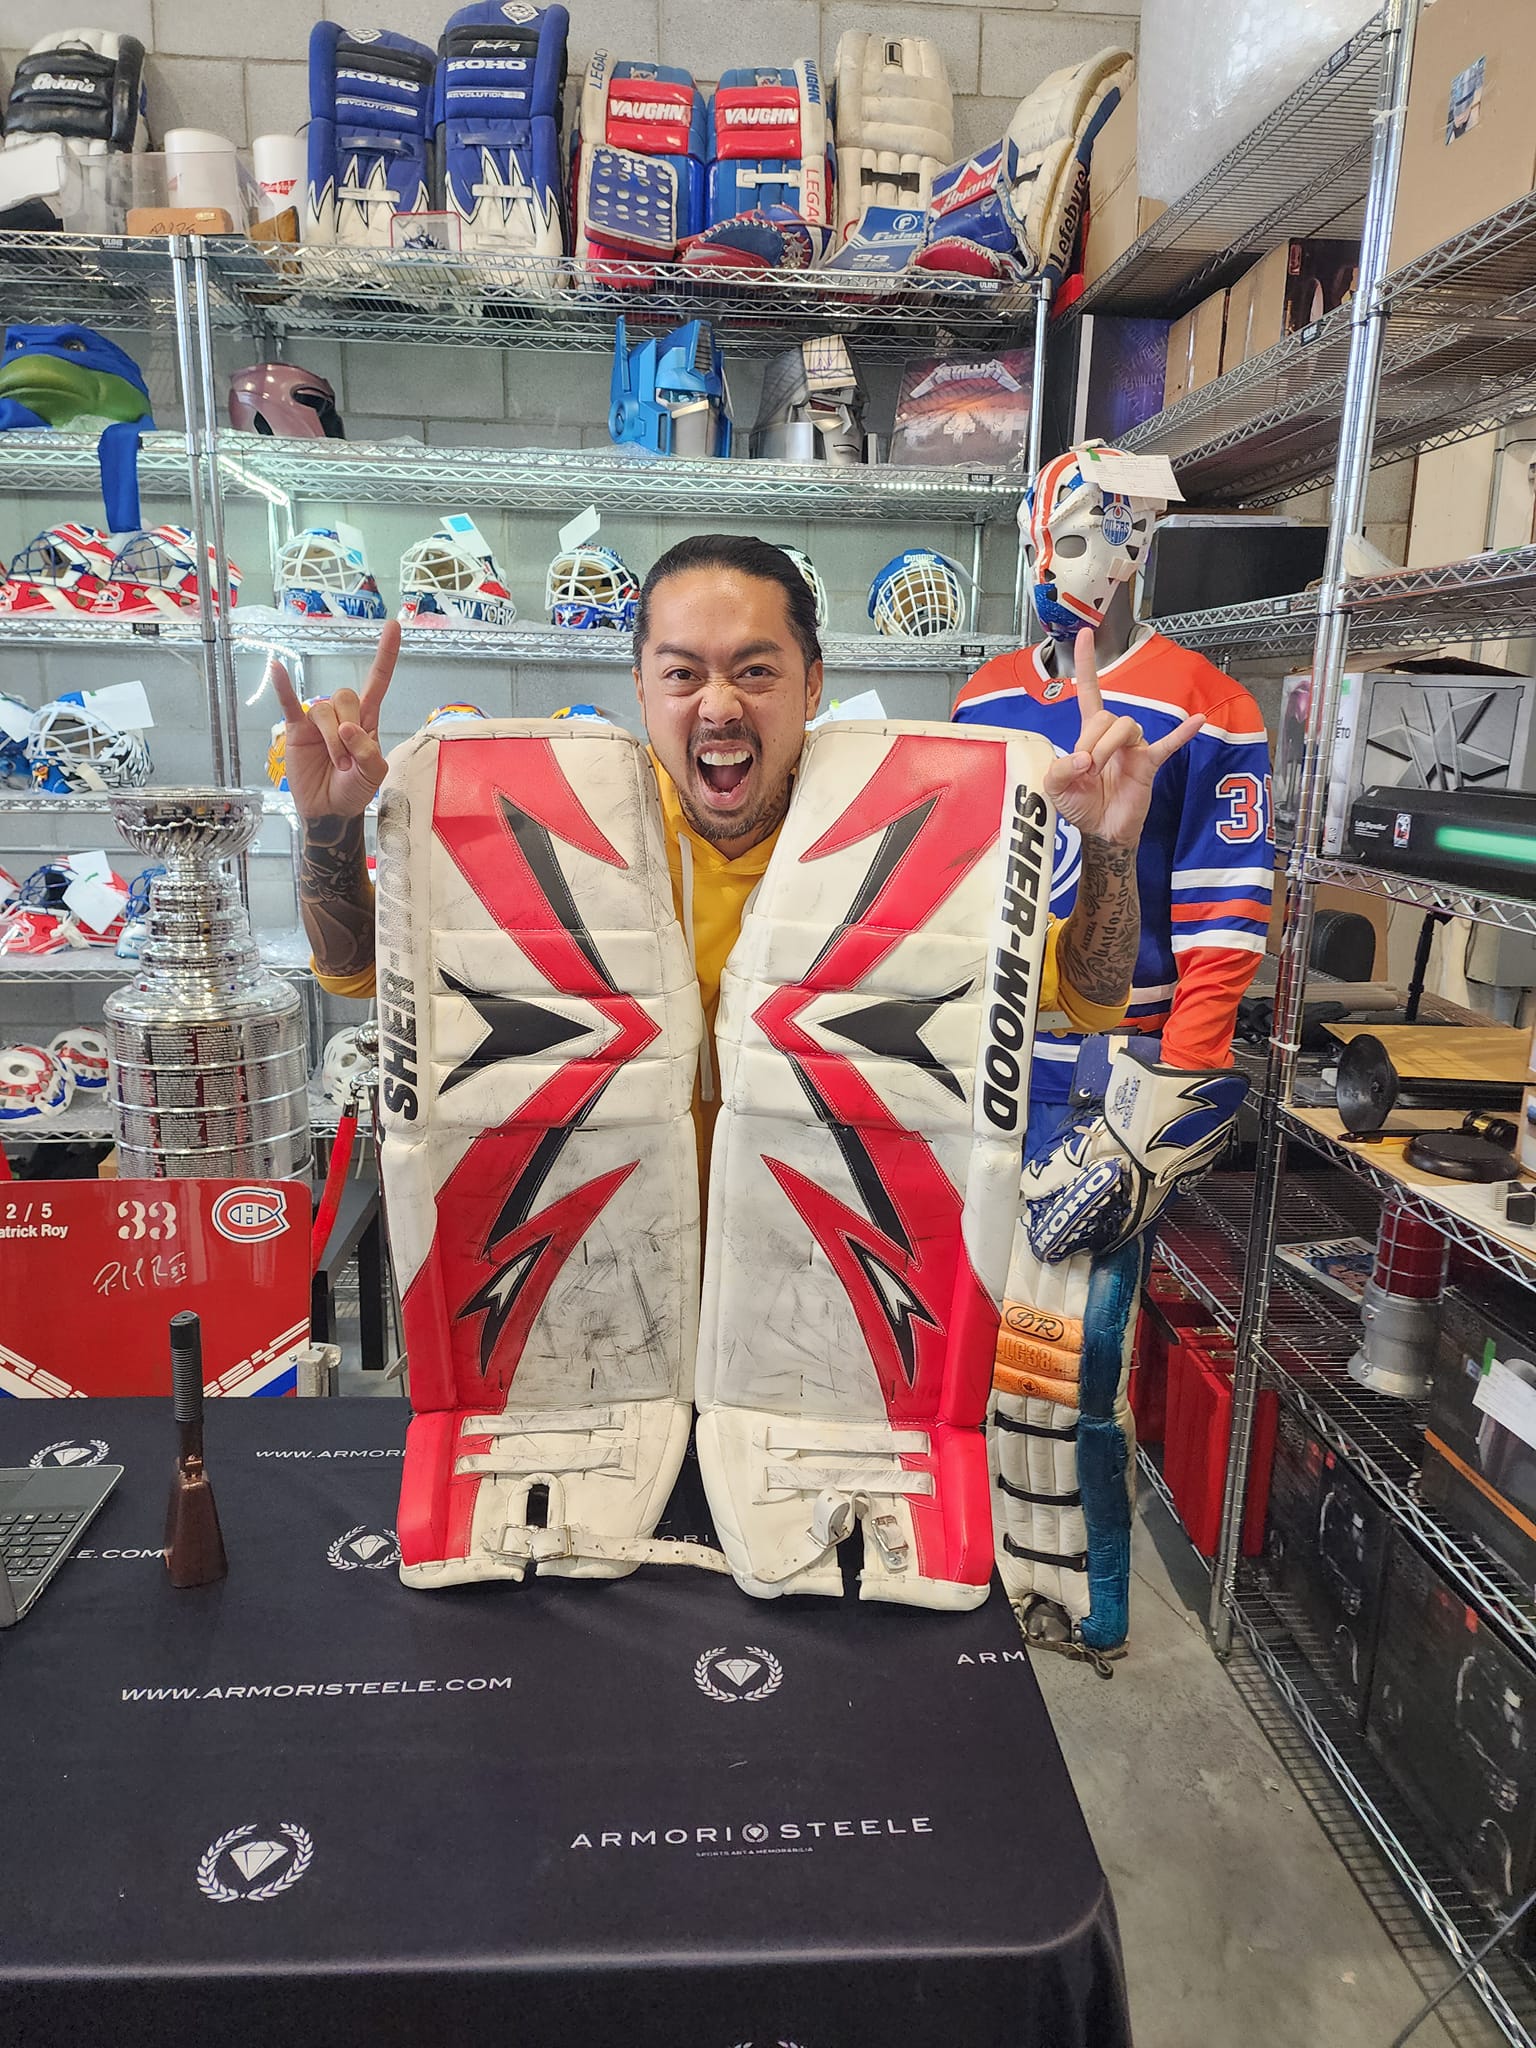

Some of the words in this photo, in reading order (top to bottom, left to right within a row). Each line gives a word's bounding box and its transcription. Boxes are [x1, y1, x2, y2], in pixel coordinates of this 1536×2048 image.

[447, 60, 527, 71] KOHO
[32, 73, 96, 93] Brian's
[336, 70, 420, 92] KOHO
[803, 60, 821, 105] VAUGHN
[610, 100, 685, 121] VAUGHN
[725, 108, 799, 125] VAUGHN
[618, 157, 648, 177] 35
[1055, 165, 1089, 267] Lefebvre
[480, 601, 515, 625] YORK
[1215, 772, 1276, 845] 31
[984, 784, 1048, 1131] SHER-WOOD
[6, 1204, 17, 1219] 2
[41, 1204, 52, 1219] 5
[117, 1200, 177, 1240] 33
[1035, 1167, 1113, 1252] KOHO
[0, 1225, 37, 1239] atrick
[40, 1224, 69, 1239] Roy
[68, 1549, 164, 1559] E.COM
[957, 1651, 1026, 1665] ARM
[122, 1677, 512, 1701] WWW.ARMORISTEELE.COM
[570, 1826, 732, 1849] ARMORI
[780, 1817, 933, 1839] STEELE
